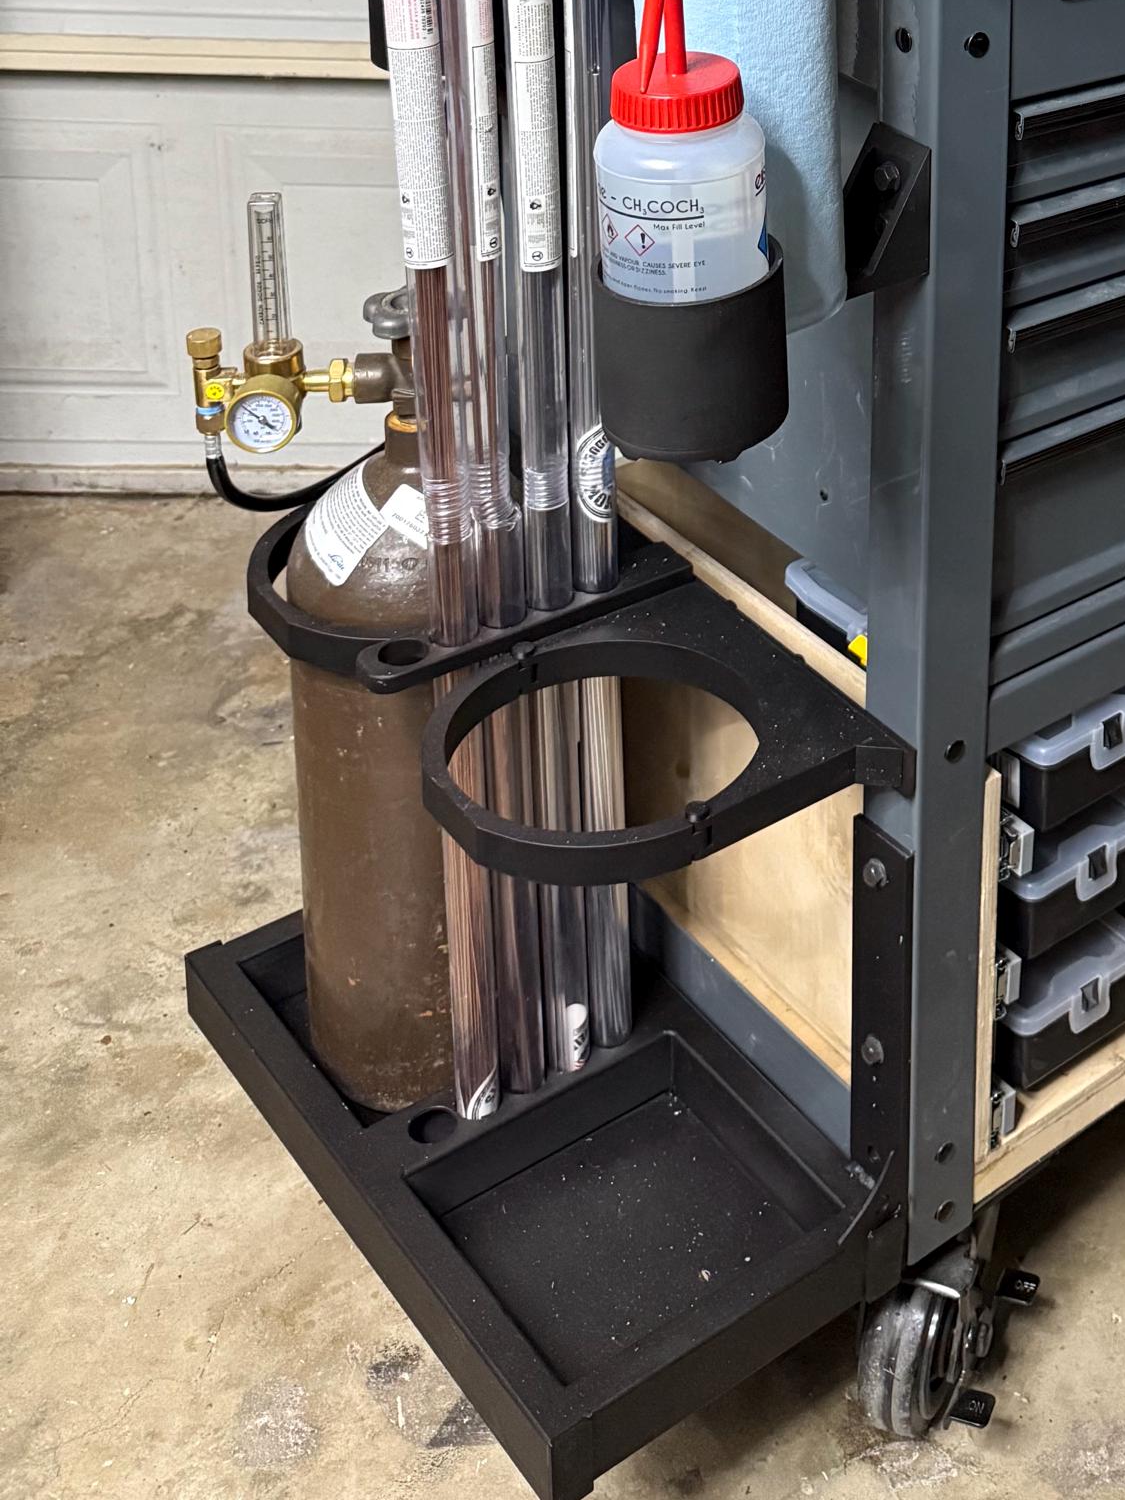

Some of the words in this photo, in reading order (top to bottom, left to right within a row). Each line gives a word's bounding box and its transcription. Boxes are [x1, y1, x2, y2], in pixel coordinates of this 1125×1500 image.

[672, 222, 683, 231] Fill
[685, 221, 706, 230] Level
[642, 261, 667, 269] CAUSES
[668, 261, 692, 269] SEVERE
[693, 260, 707, 268] EYE
[968, 1399, 985, 1415] ON
